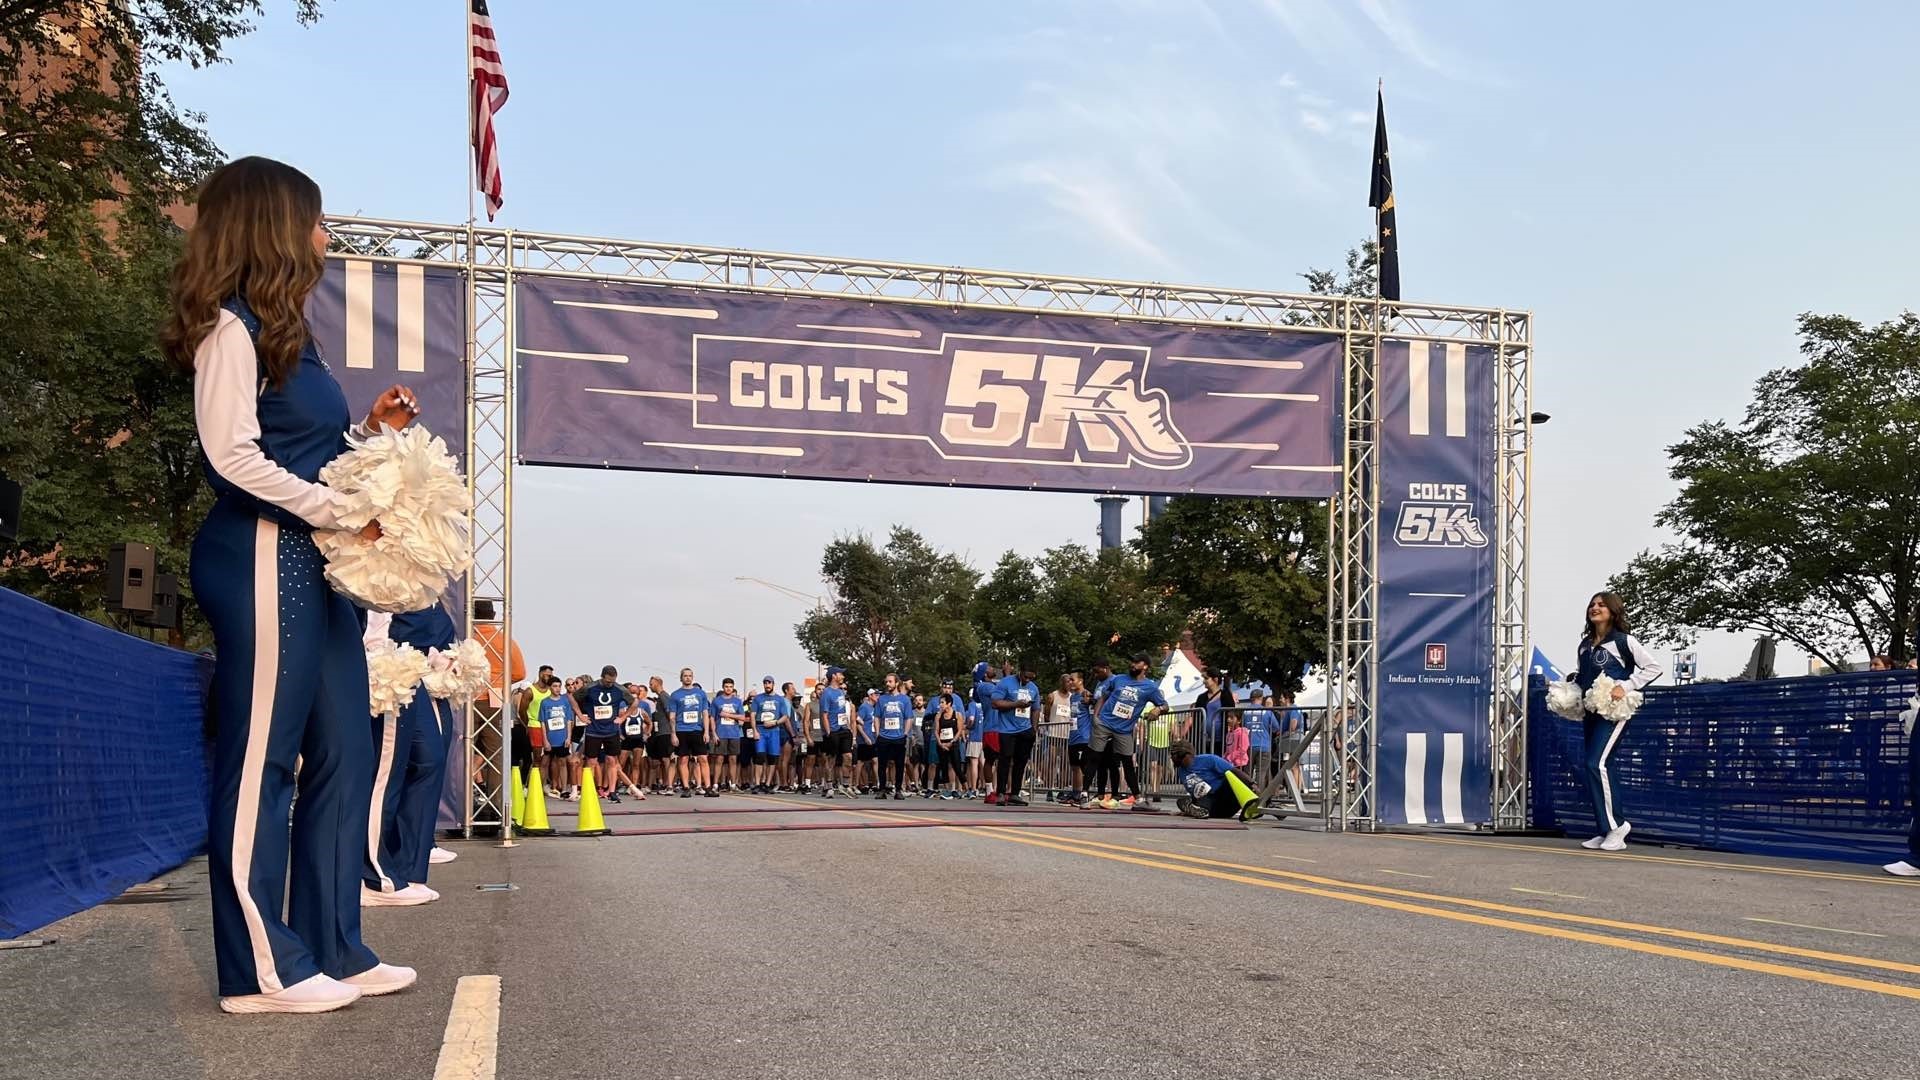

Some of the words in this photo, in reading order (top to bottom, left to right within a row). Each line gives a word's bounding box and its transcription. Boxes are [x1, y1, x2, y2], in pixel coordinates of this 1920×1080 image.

[729, 360, 909, 416] COLTS
[939, 349, 1136, 453] 5K
[1409, 483, 1467, 500] COLTS
[1398, 507, 1468, 542] 5K
[1388, 674, 1416, 683] Indiana
[1418, 674, 1455, 686] University
[1456, 675, 1481, 684] Health
